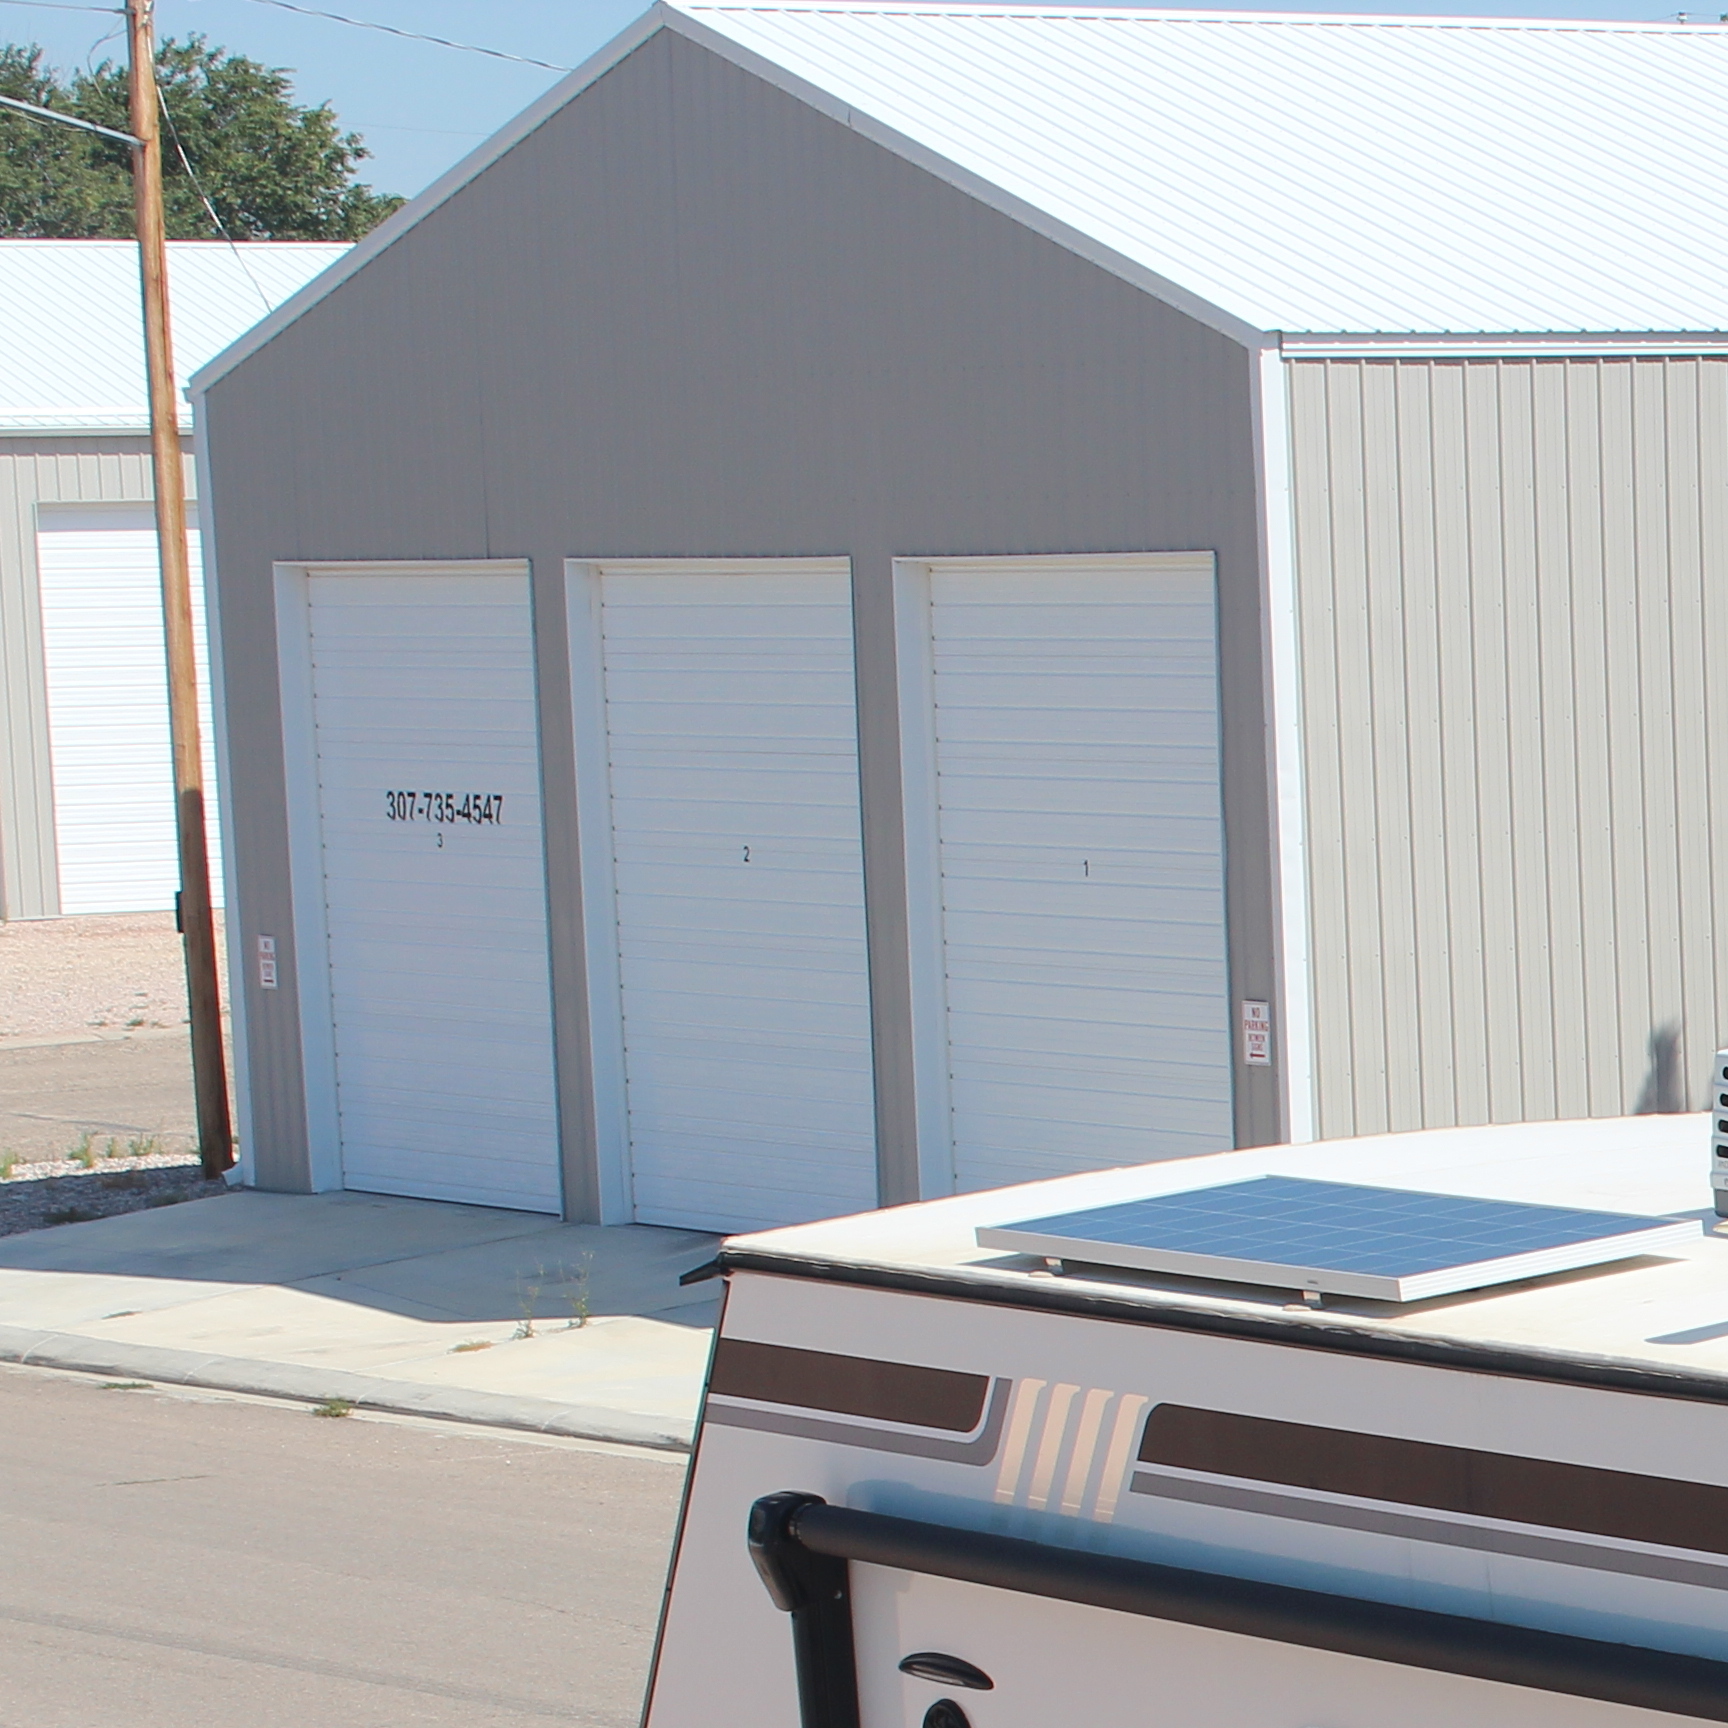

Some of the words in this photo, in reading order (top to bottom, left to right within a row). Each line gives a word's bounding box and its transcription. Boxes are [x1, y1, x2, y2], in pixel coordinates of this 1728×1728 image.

[386, 791, 502, 825] 307-735-4547
[436, 832, 443, 848] 3
[743, 846, 750, 862] 2
[1084, 859, 1089, 877] 1
